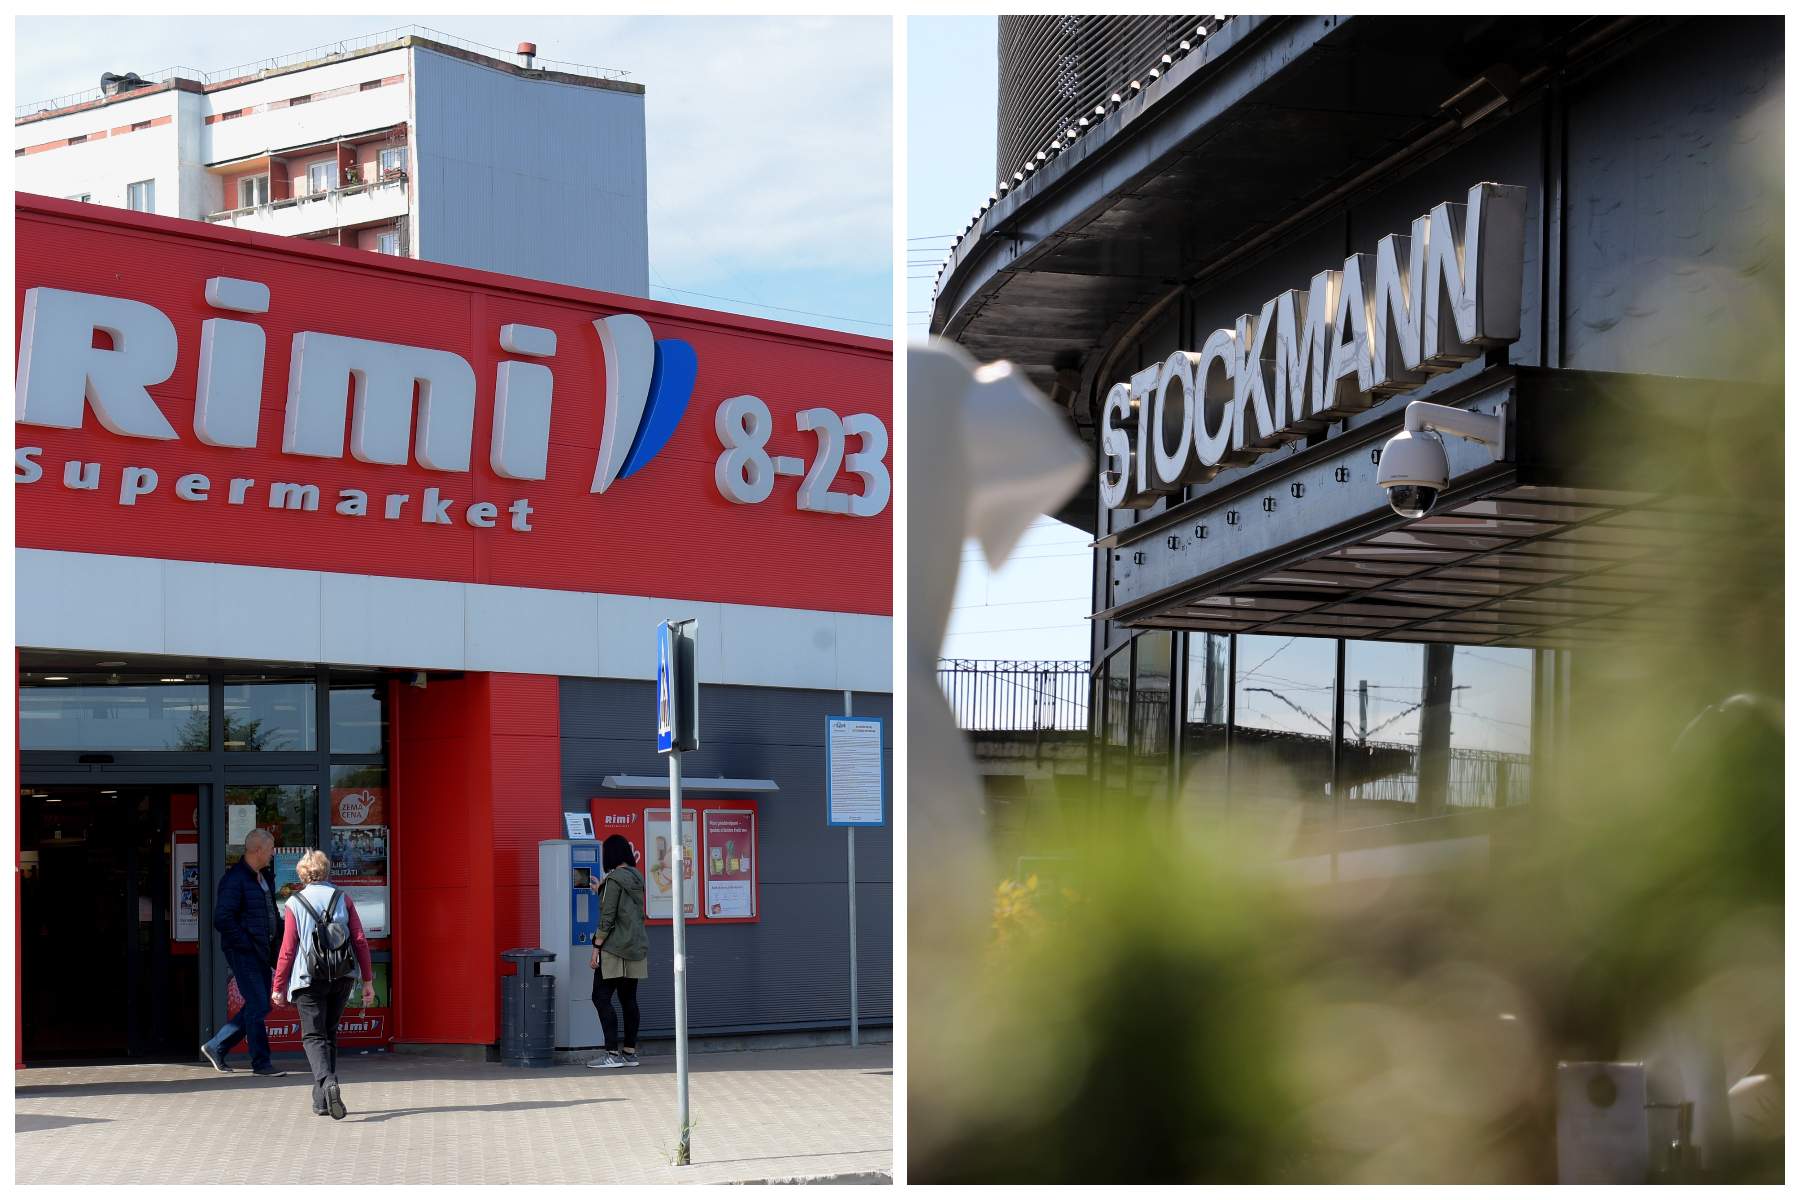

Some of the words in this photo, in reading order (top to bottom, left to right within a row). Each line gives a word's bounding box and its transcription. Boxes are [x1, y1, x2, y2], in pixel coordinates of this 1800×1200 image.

[15, 276, 557, 480] Rimi
[1099, 182, 1527, 509] STOCKMANN
[15, 446, 533, 532] Supermarket
[715, 394, 891, 517] 8-23
[604, 814, 630, 824] Rimi
